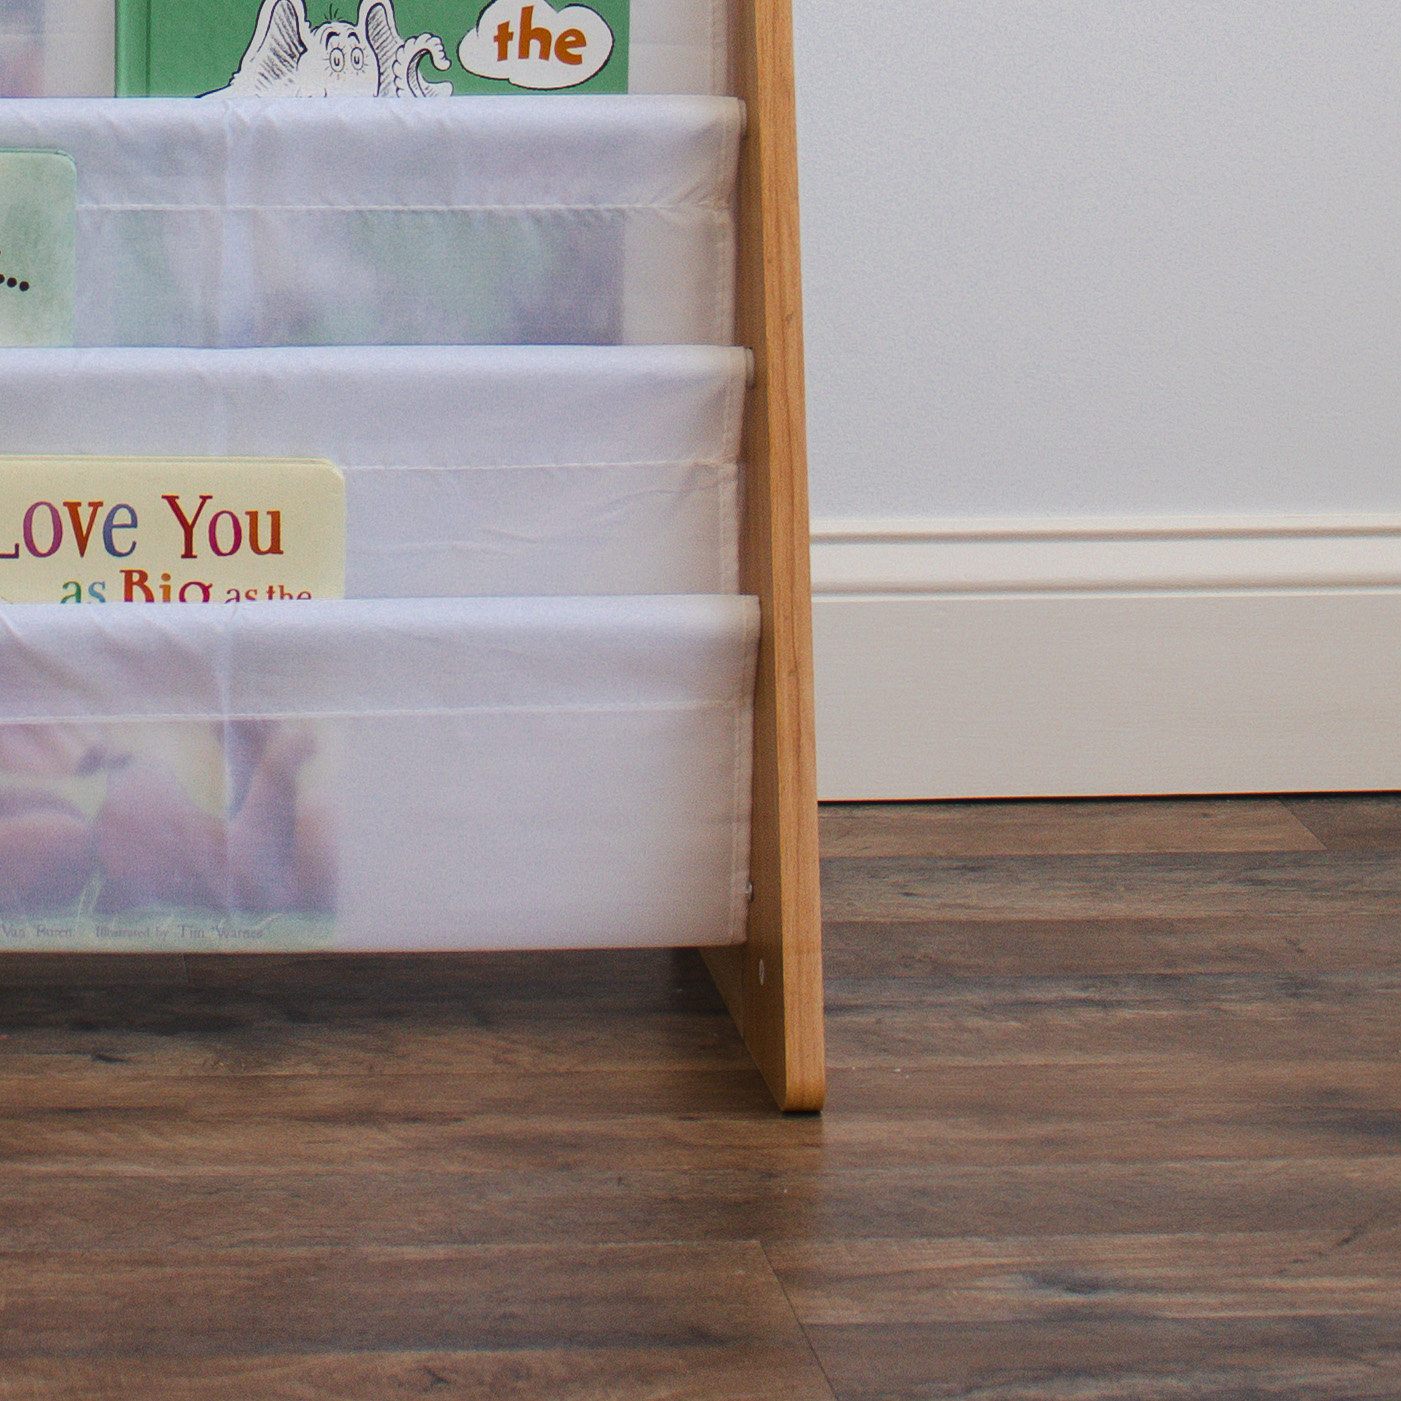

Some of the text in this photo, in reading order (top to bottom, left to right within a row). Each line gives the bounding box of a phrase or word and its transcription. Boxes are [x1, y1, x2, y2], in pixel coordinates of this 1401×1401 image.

[493, 4, 589, 66] the
[161, 494, 285, 560] You
[60, 580, 107, 604] as
